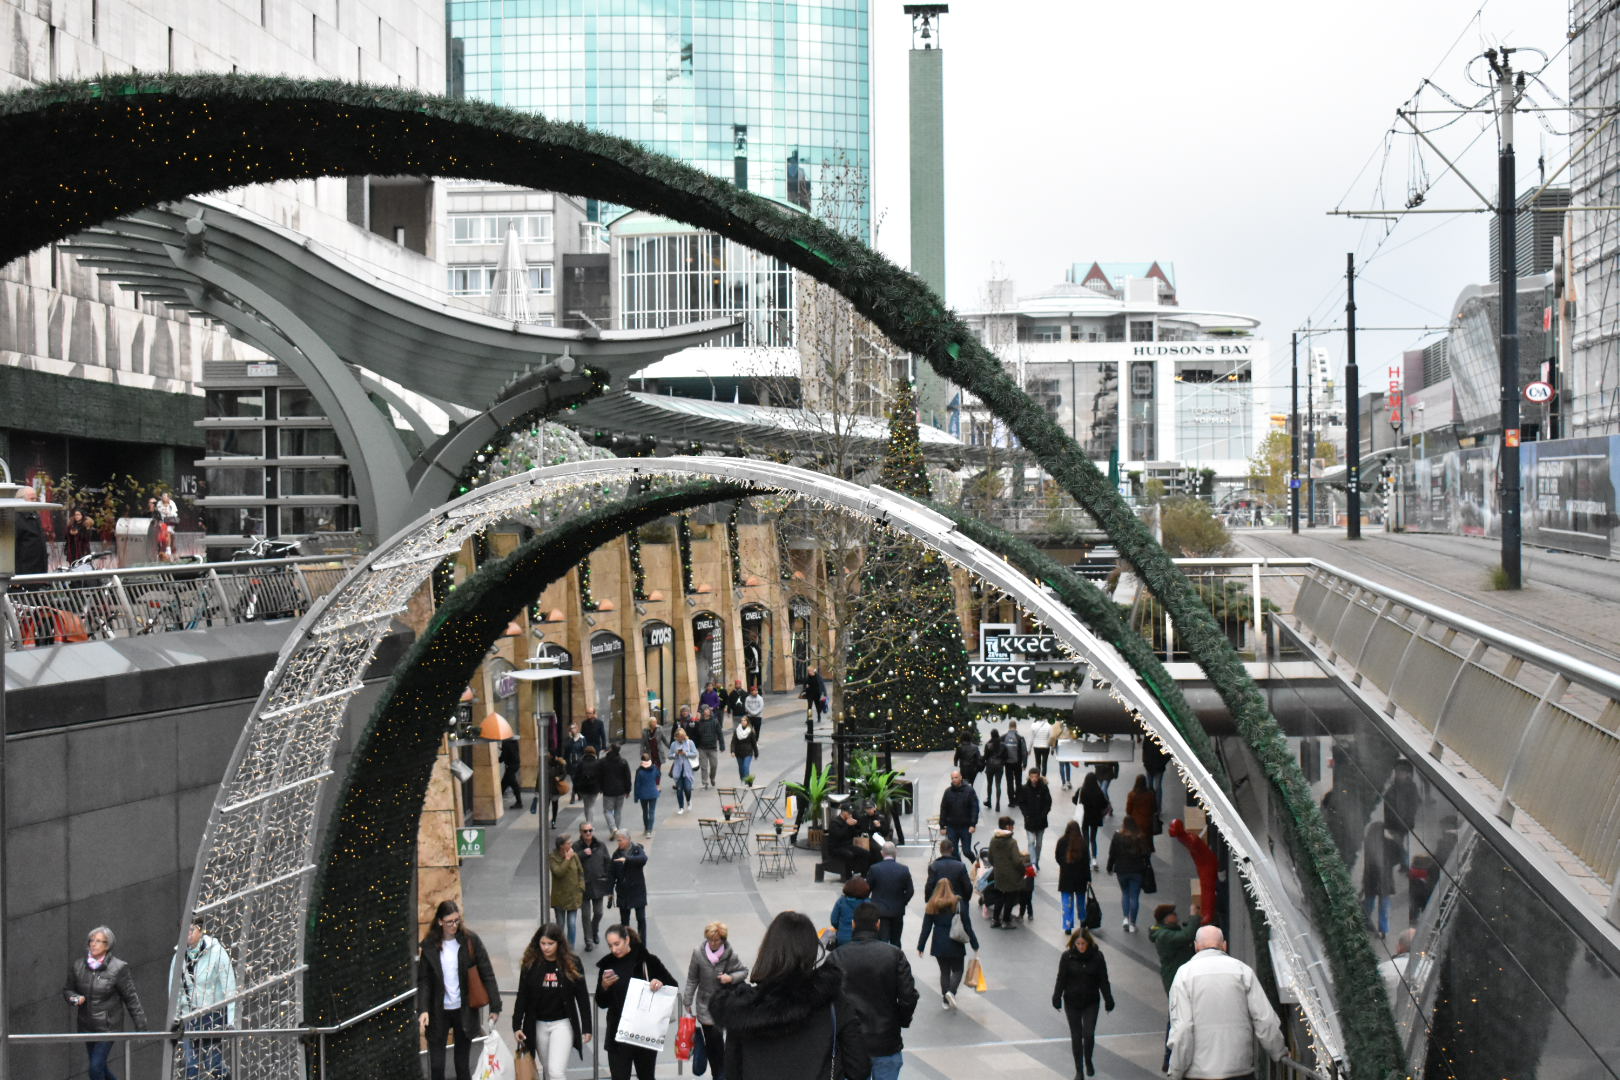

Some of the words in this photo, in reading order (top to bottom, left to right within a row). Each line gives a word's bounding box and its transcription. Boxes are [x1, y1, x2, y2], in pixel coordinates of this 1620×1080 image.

[1220, 345, 1251, 354] BAY
[1388, 365, 1401, 422] HEMA
[1528, 386, 1548, 398] C&A
[651, 626, 672, 646] crocs
[461, 843, 481, 851] AED
